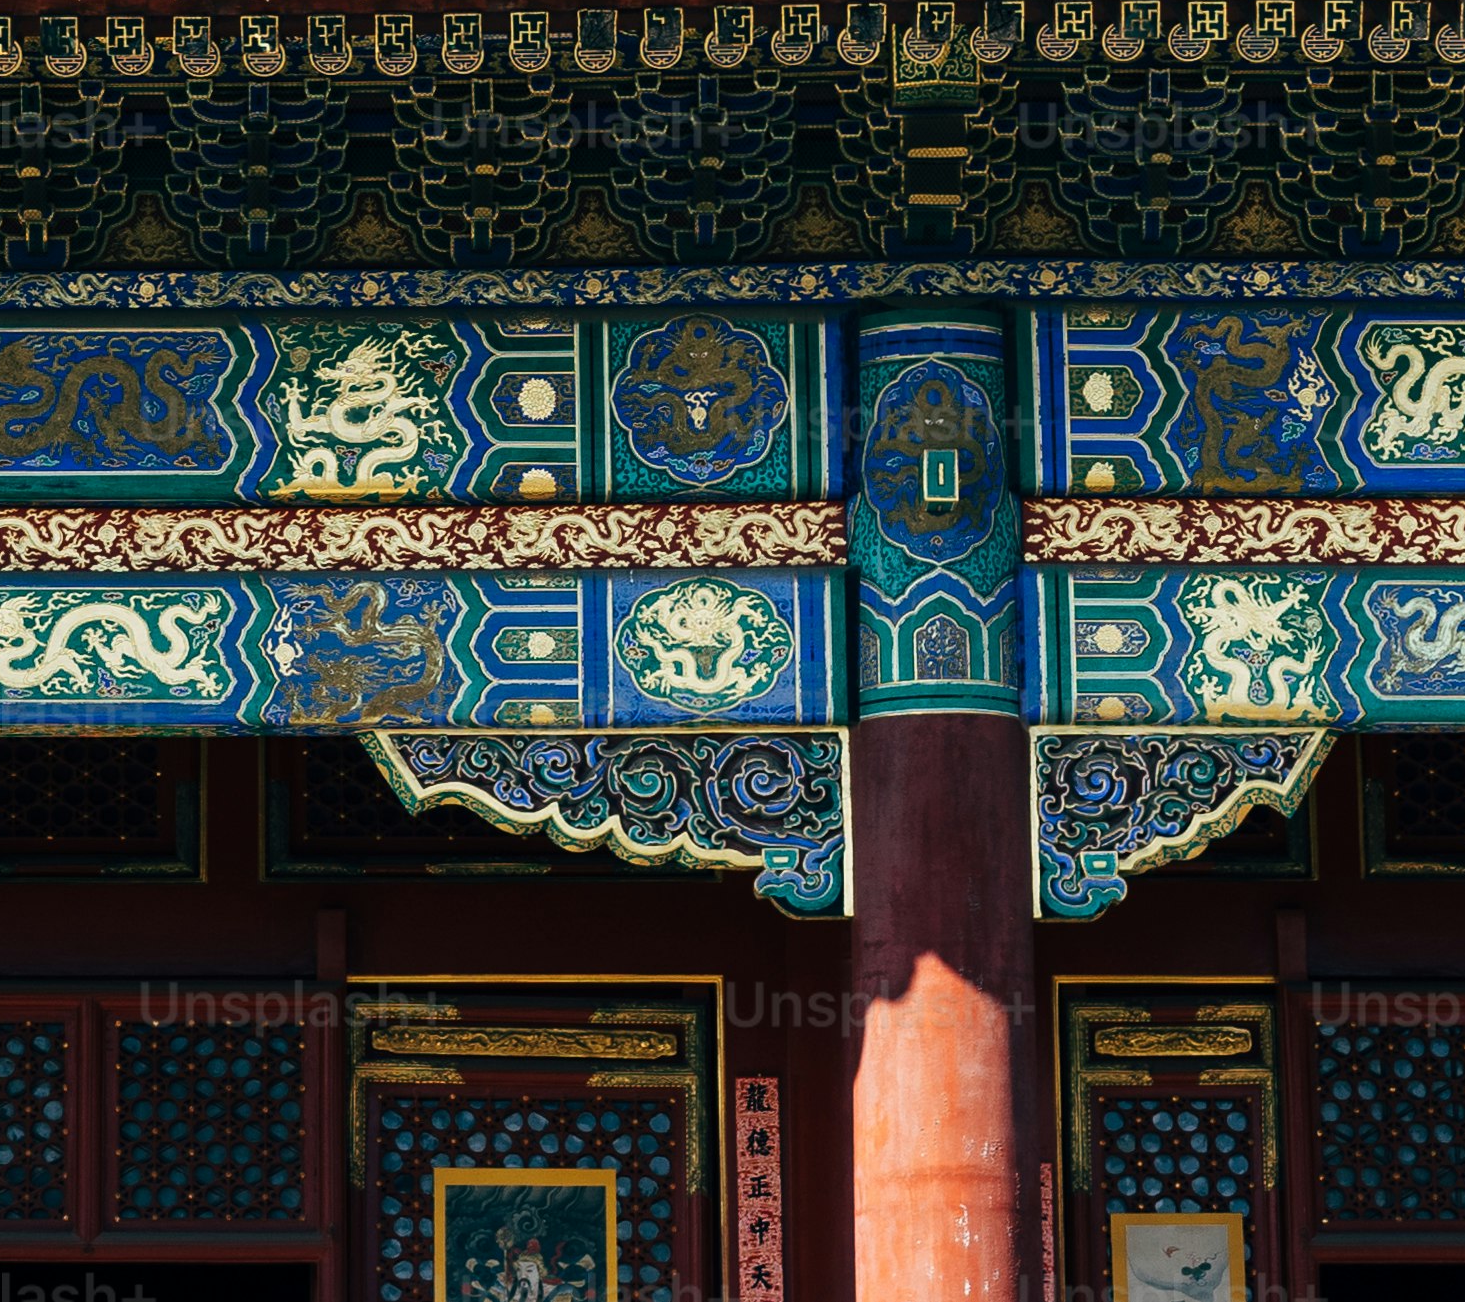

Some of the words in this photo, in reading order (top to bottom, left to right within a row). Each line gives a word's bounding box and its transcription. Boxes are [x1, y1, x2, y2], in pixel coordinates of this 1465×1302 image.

[745, 1083, 774, 1290] 龍德正中天
